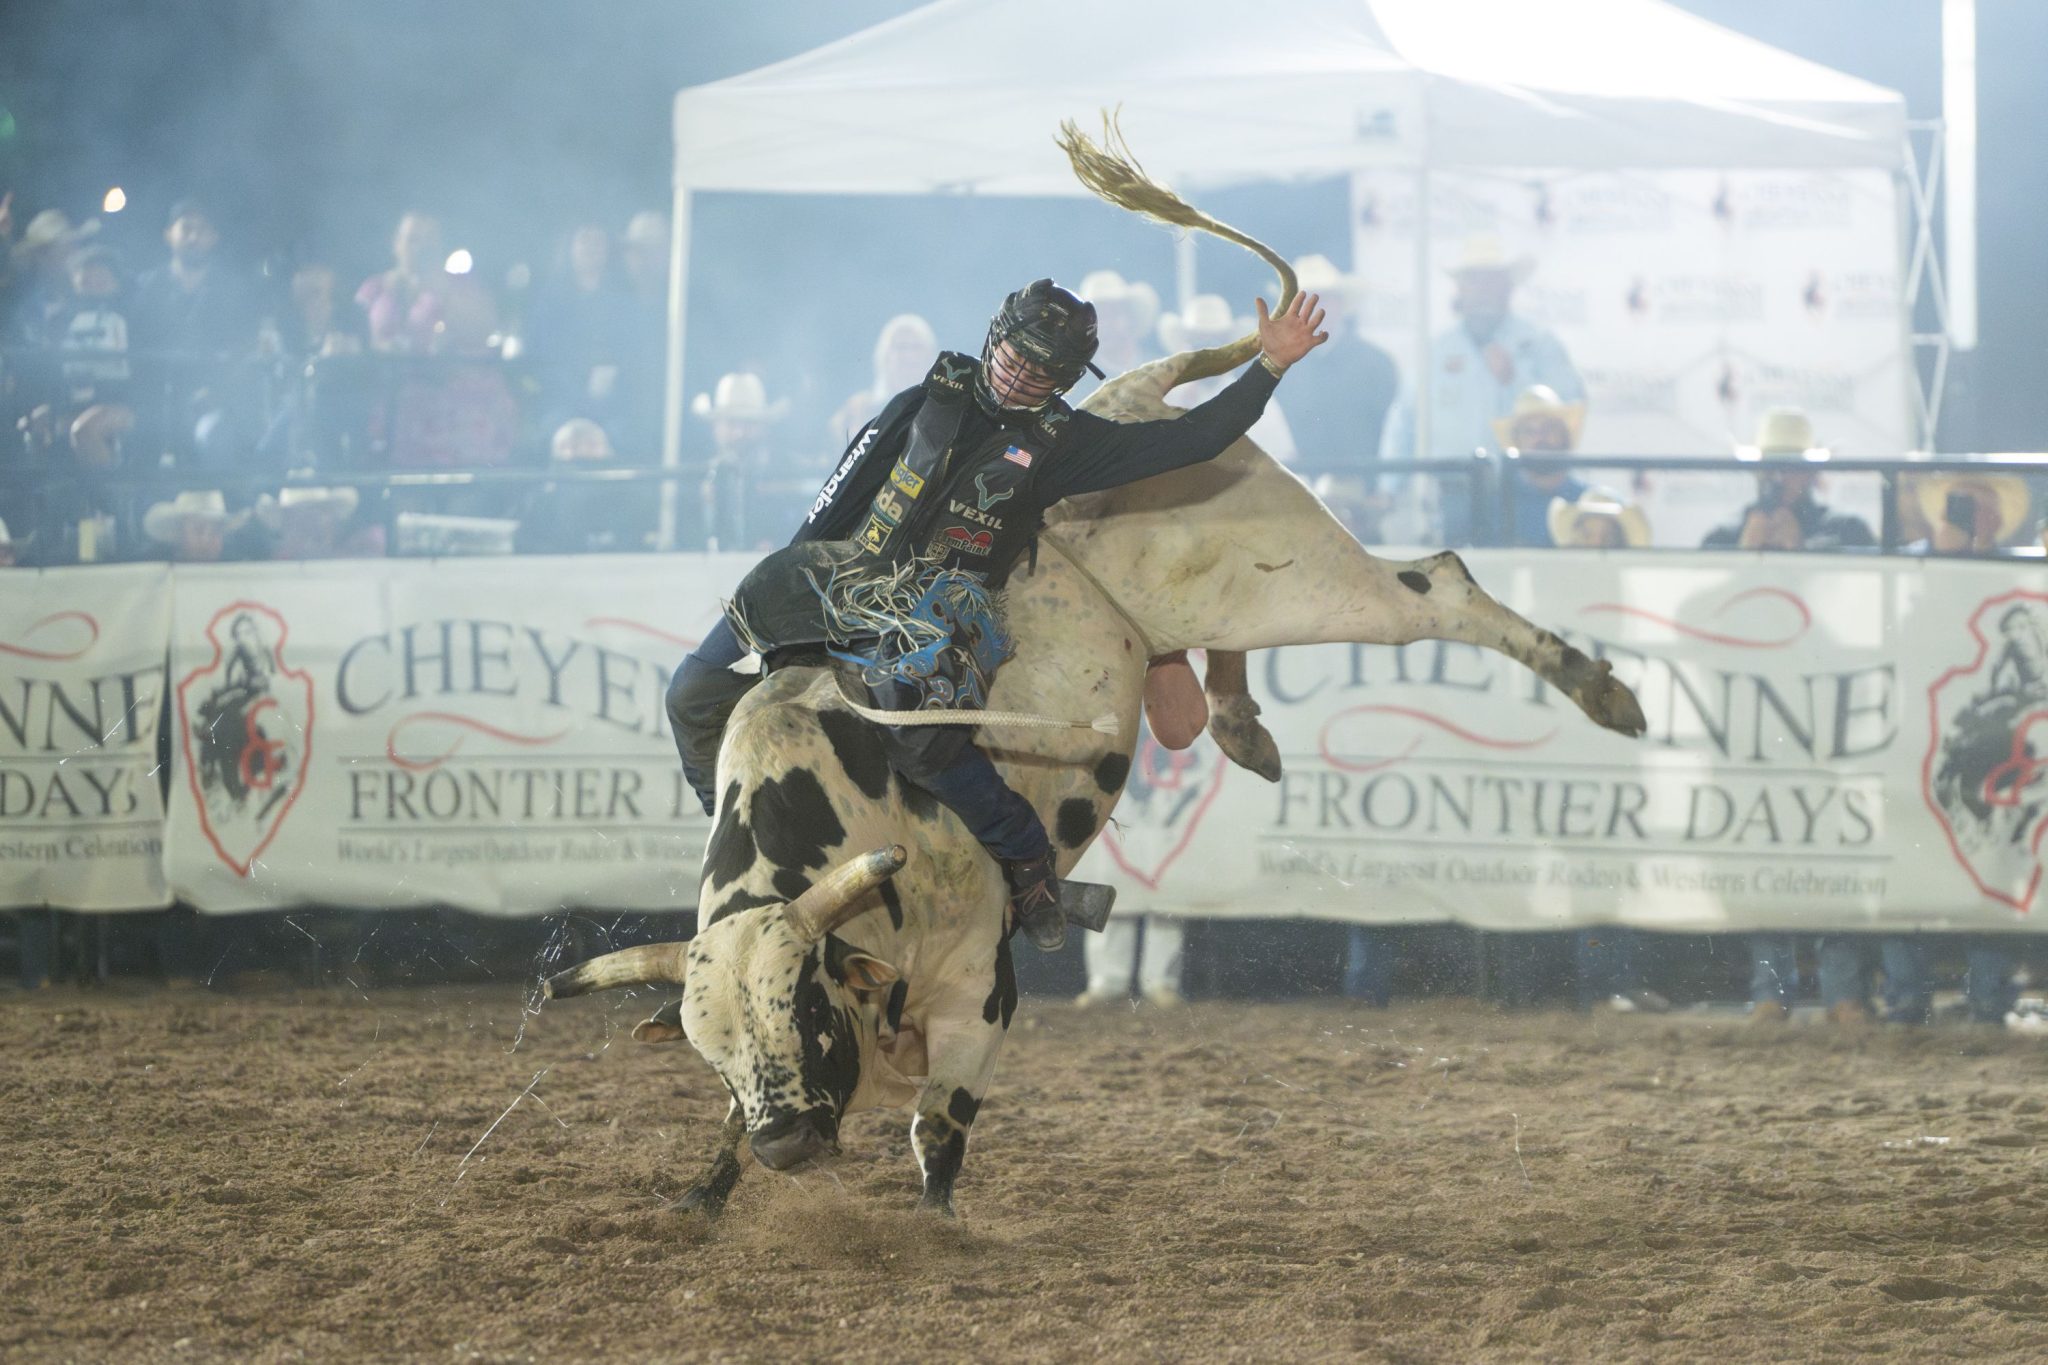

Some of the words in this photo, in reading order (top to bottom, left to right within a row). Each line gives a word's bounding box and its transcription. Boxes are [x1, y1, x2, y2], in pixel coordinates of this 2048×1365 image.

[933, 373, 964, 391] VEXIL
[809, 429, 879, 524] Wrangler
[949, 499, 1003, 530] VEXIL
[336, 619, 675, 738] CHEYE
[348, 767, 643, 822] FRONTIER
[1275, 769, 1648, 840] FRONTIER
[1683, 785, 1874, 847] DAYS
[1446, 857, 1538, 883] Outdoor
[1547, 859, 1621, 888] Rodeo
[1652, 862, 1746, 893] Western
[1752, 865, 1889, 897] Celebration
